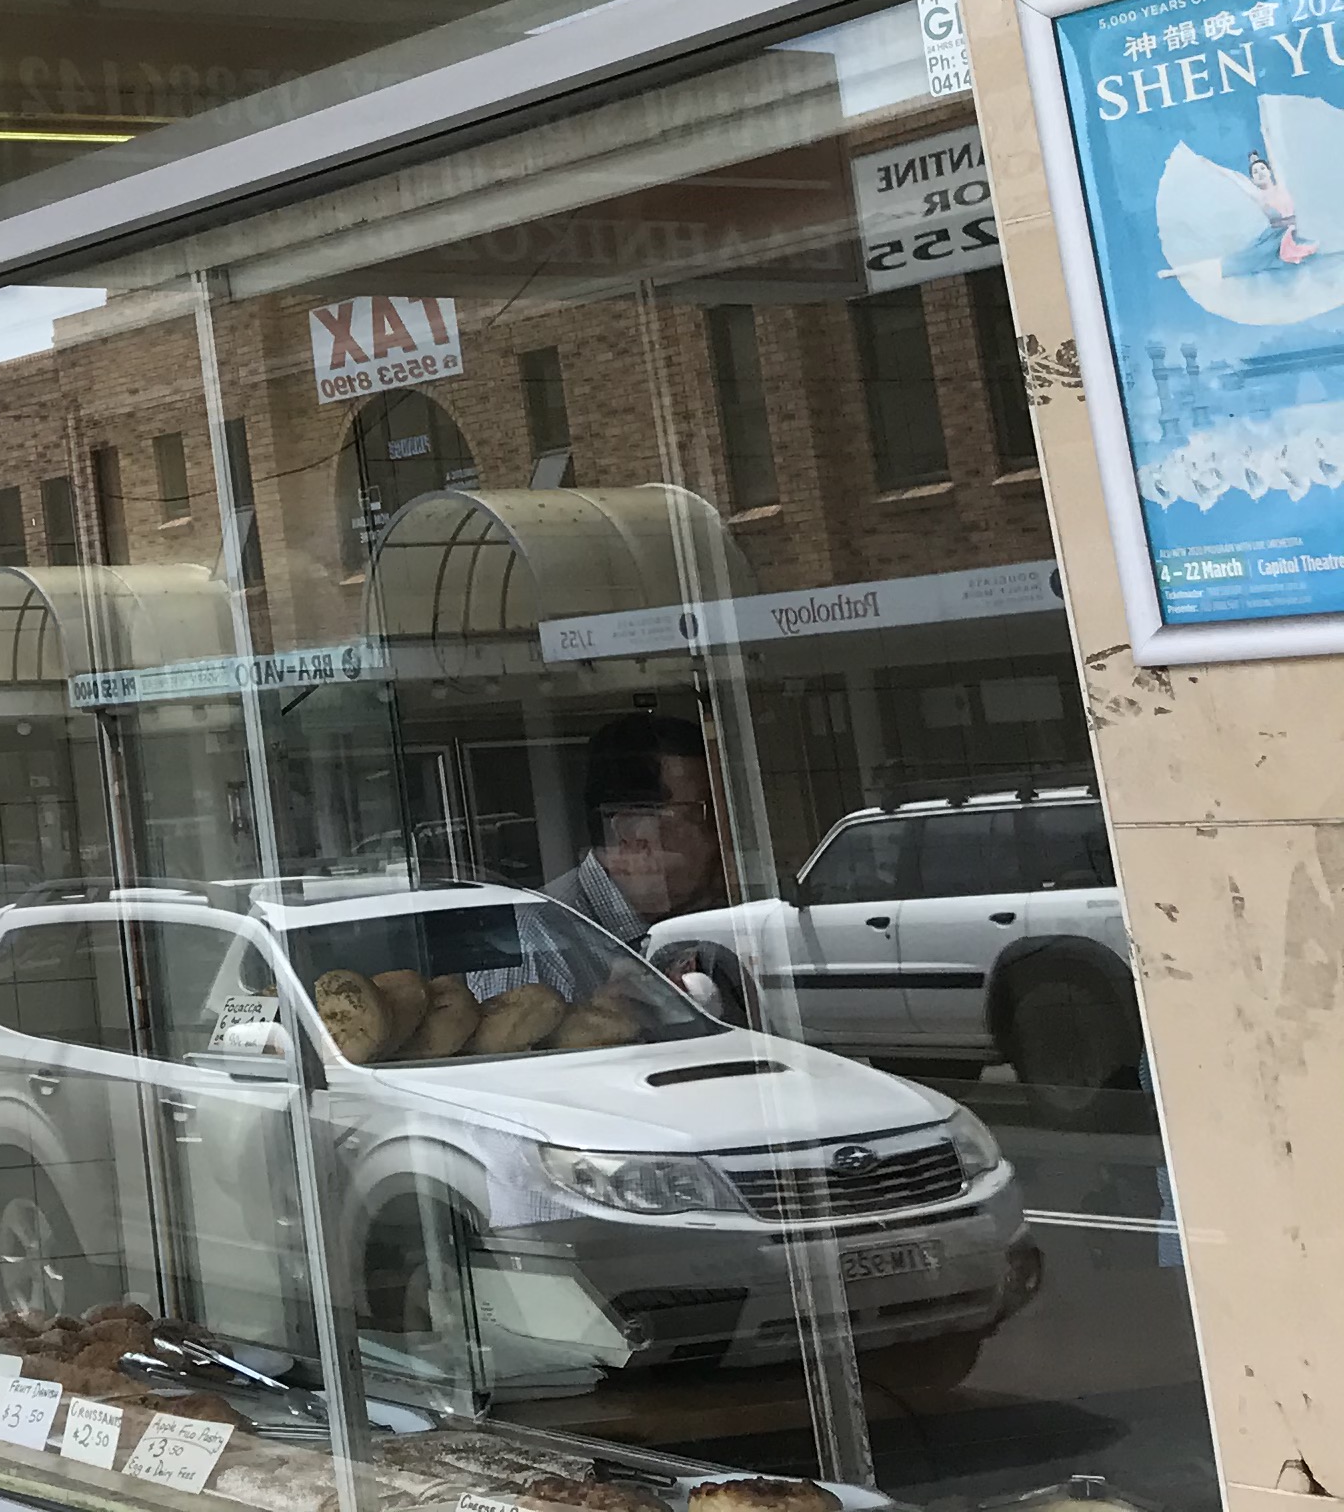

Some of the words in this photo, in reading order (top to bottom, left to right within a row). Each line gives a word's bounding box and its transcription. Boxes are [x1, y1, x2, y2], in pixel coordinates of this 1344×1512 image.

[1098, 10, 1137, 30] 5,000
[1123, 0, 1279, 63] 神韻晚會
[928, 55, 956, 74] Ph:
[1096, 41, 1258, 121] SHEN
[1272, 21, 1344, 78] YU
[1160, 565, 1170, 583] 4
[1184, 562, 1201, 581] 22
[1202, 558, 1243, 578] March
[1258, 556, 1299, 577] Capitol
